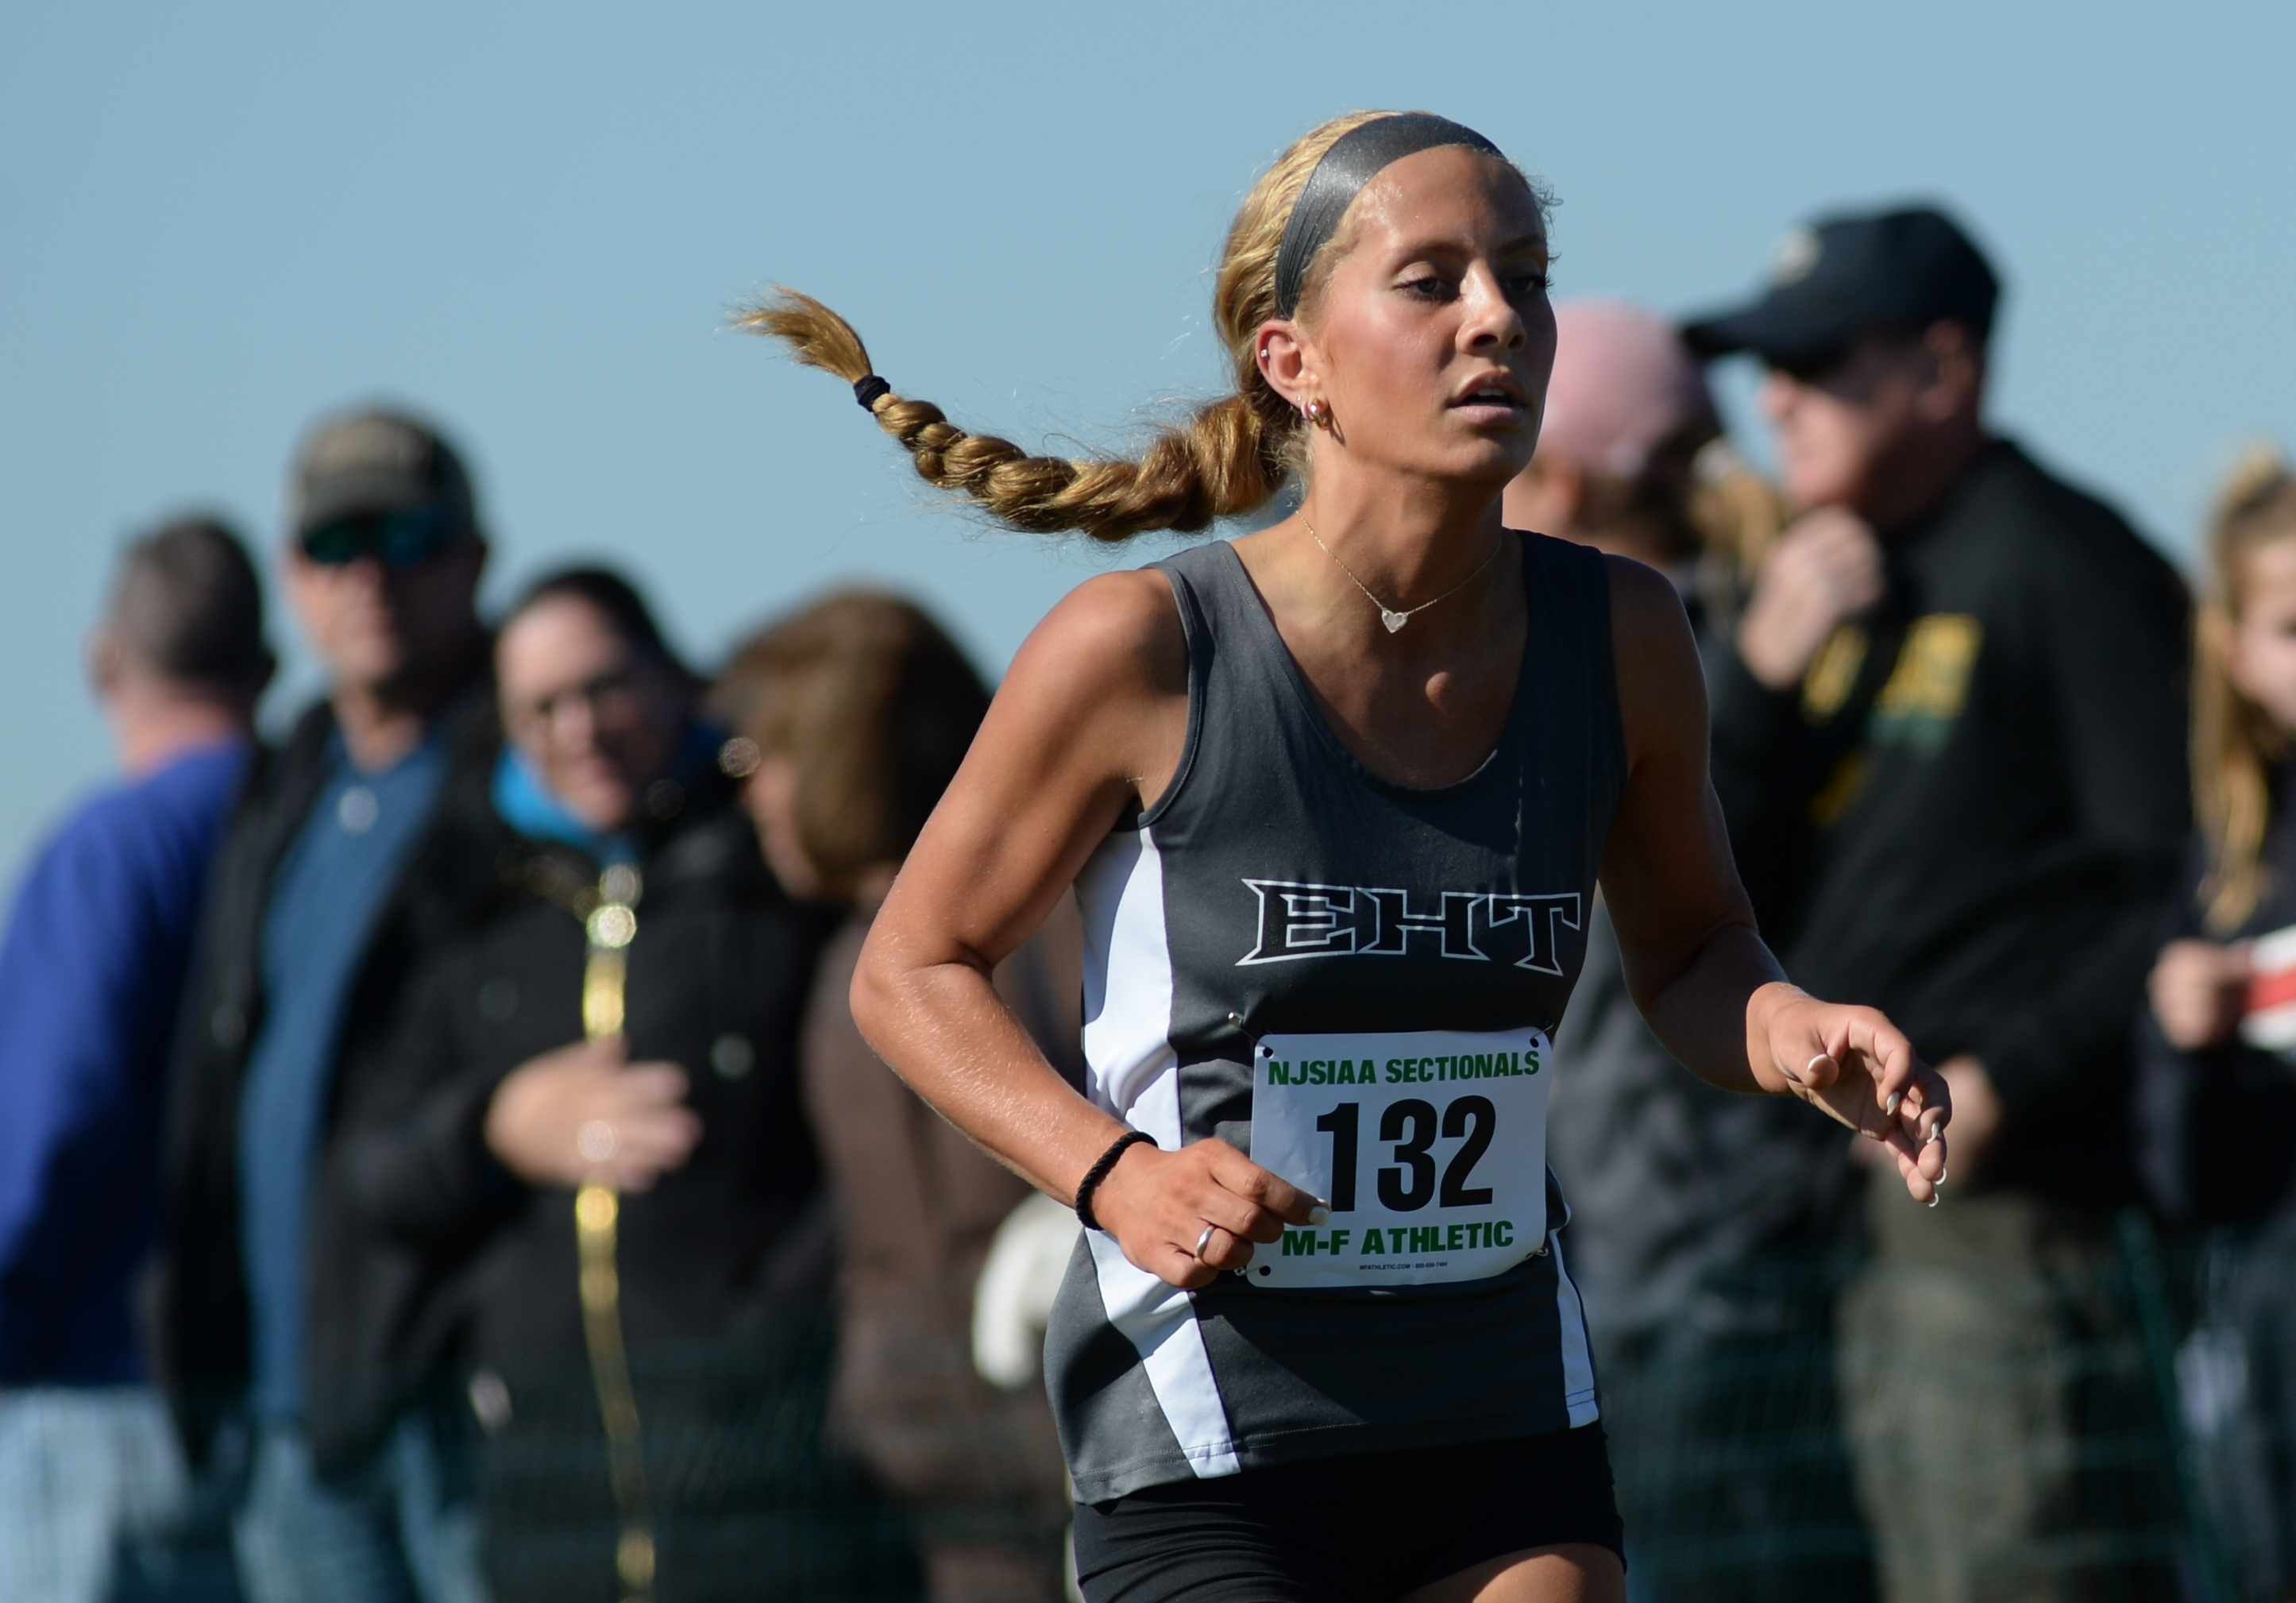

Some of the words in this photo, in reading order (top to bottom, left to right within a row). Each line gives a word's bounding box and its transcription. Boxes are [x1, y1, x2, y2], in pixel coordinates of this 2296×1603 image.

[1235, 878, 1580, 976] EHT
[1268, 1059, 1376, 1086] NJSIAA
[1385, 1050, 1540, 1084] SECTIONALS
[1316, 1095, 1496, 1212] 132
[1282, 1230, 1350, 1256] M-F
[1360, 1220, 1514, 1255] ATHLETIC
